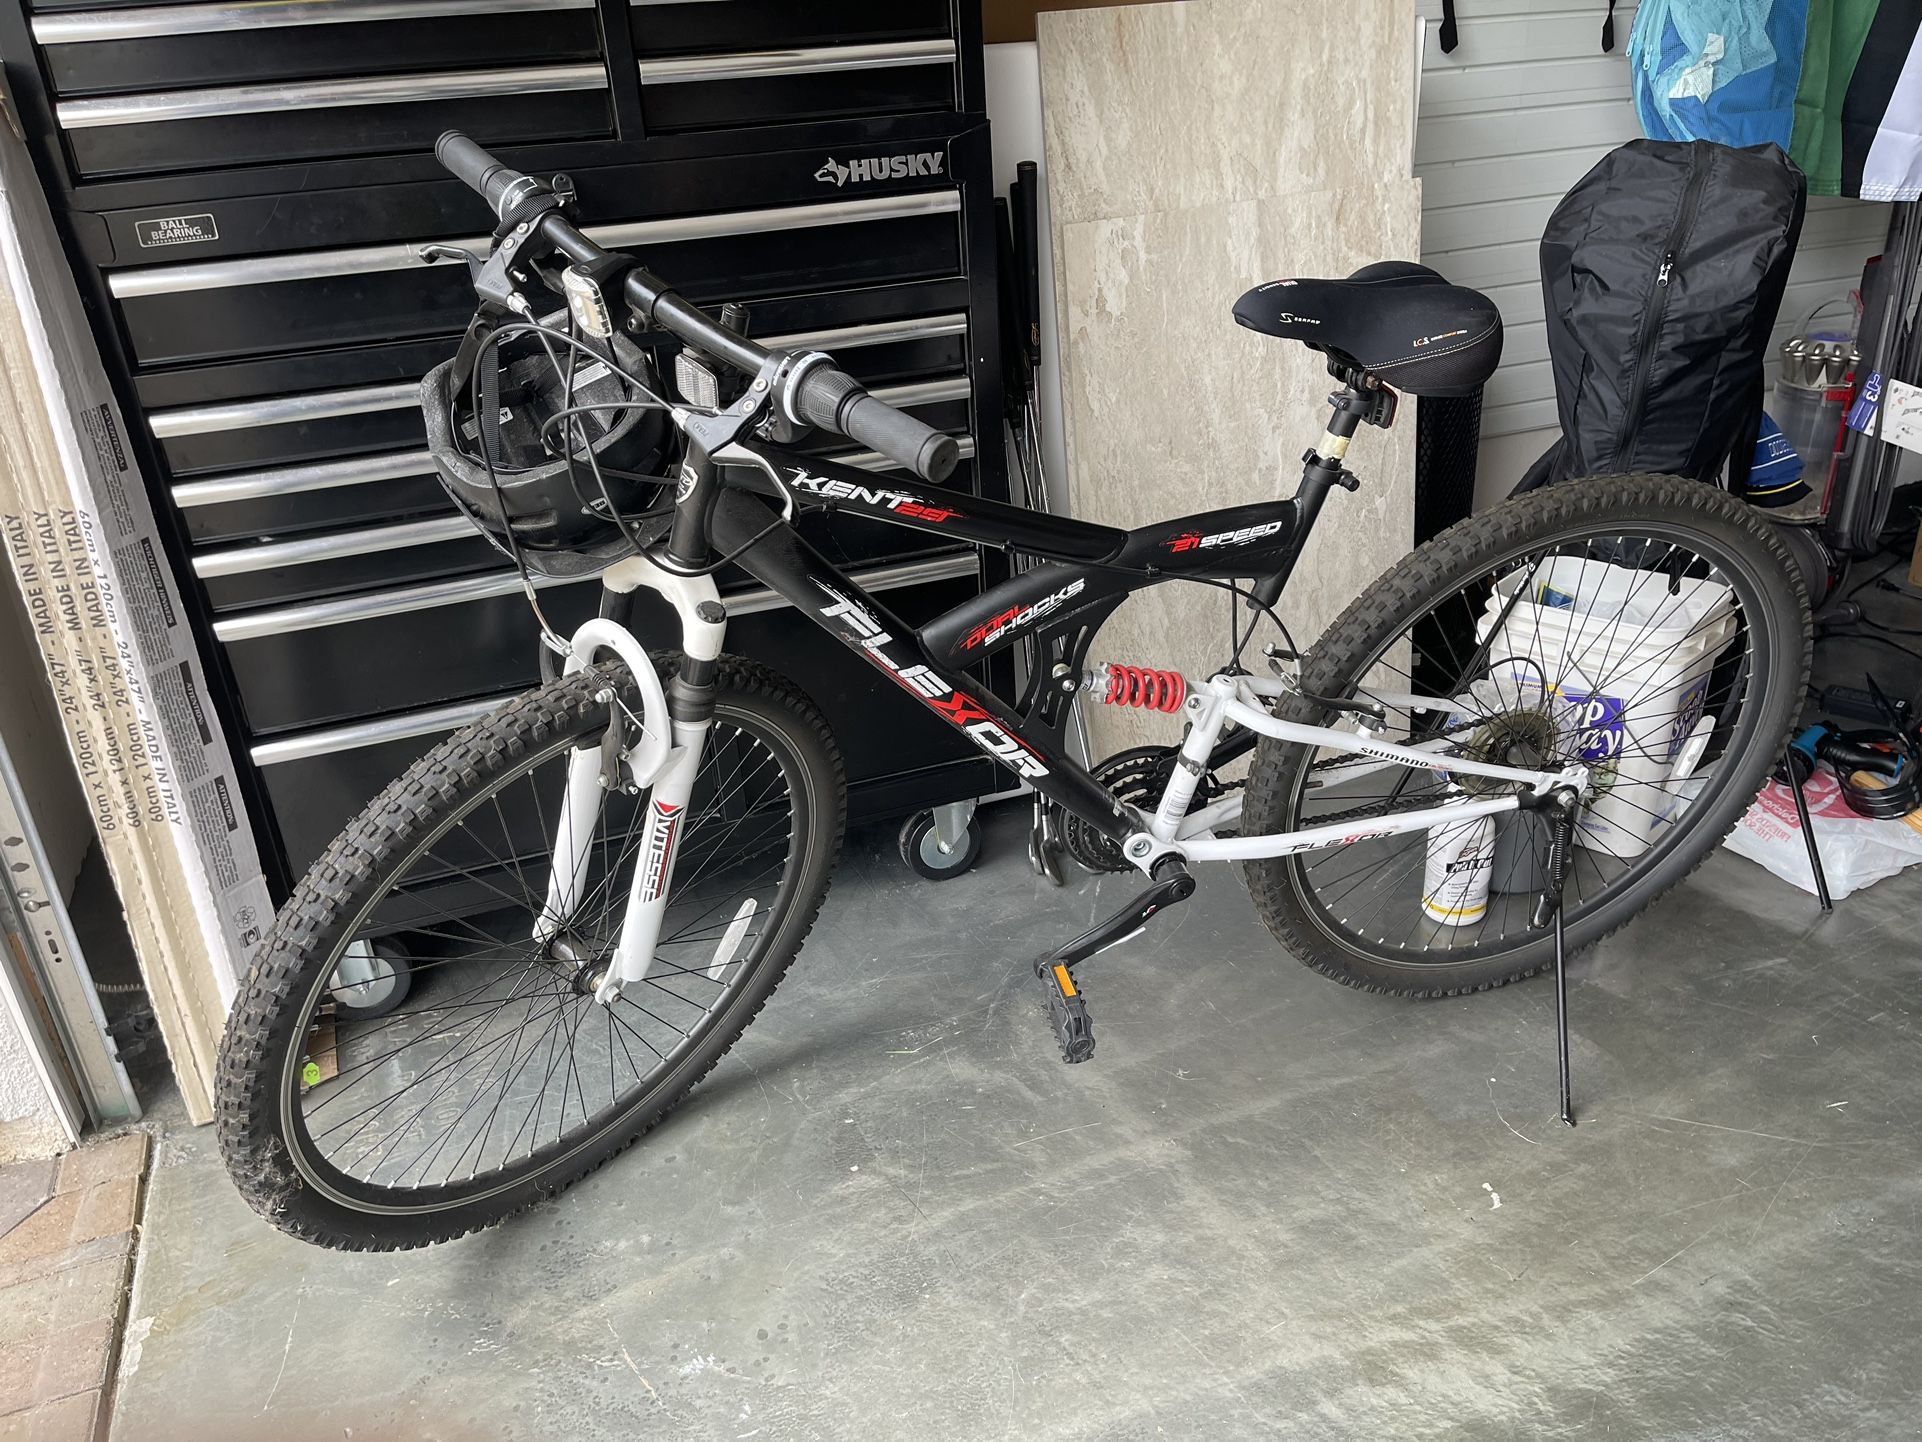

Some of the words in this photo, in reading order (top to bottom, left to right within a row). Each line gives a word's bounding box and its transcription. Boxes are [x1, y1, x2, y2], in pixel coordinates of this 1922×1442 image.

[849, 152, 943, 183] HUSKY
[150, 226, 202, 240] BEARING
[160, 219, 190, 230] BALL
[785, 467, 924, 509] KENT
[893, 502, 962, 523] 29
[5, 514, 31, 558] ITALY
[33, 511, 59, 554] ITALY
[58, 508, 85, 552] ITALY
[78, 510, 96, 553] 60cm
[1166, 533, 1200, 553] 21
[1199, 520, 1283, 548] SPEED
[20, 564, 39, 583] IN
[48, 560, 67, 579] IN
[73, 557, 92, 576] IN
[28, 587, 55, 635] MADE
[56, 584, 82, 631] MADE
[80, 581, 107, 628] MADE
[97, 573, 117, 624] 120cm
[984, 578, 1085, 647] SHOCKS
[814, 590, 1050, 779] FLEXOR
[76, 730, 98, 778] 120cm
[104, 727, 124, 774] 120cm
[127, 722, 148, 770] 120cm
[140, 719, 163, 763] MADE
[1360, 746, 1429, 768] SHIMANO
[155, 768, 170, 783] IN
[98, 794, 116, 831] 60cm
[124, 791, 141, 828] 60cm
[145, 785, 164, 823] 60cm
[162, 788, 182, 826] ITALY
[643, 818, 671, 903] VITESSE
[1290, 830, 1394, 852] FLEXOR
